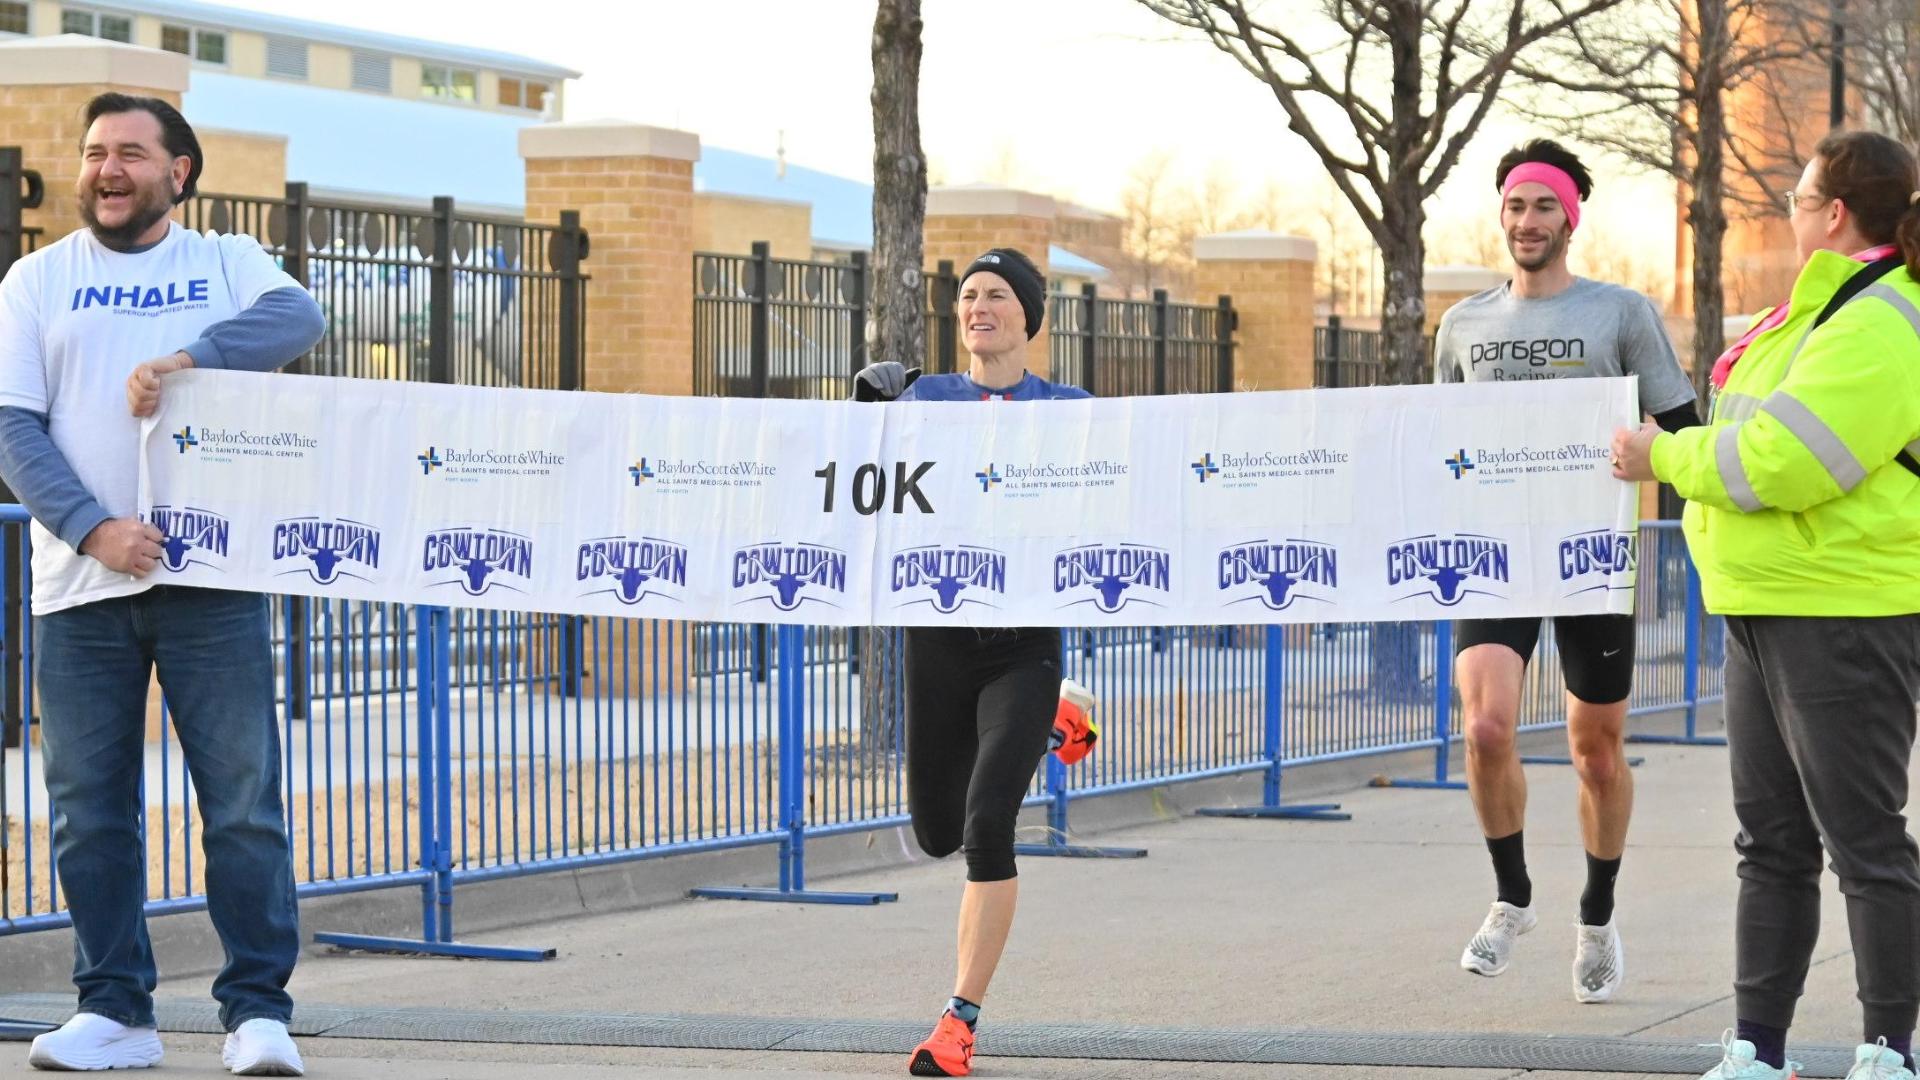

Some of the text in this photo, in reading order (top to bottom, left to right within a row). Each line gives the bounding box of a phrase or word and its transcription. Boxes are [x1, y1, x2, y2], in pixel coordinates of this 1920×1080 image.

[72, 279, 208, 311] INHALE
[1471, 338, 1585, 371] paragon
[243, 449, 273, 457] MEDICAL
[1525, 465, 1560, 473] MEDICAL
[814, 461, 937, 515] 10K
[272, 521, 380, 569] COWTOWN
[423, 532, 533, 579] COWTOWN
[576, 541, 688, 587] COWTOWN
[1218, 543, 1338, 590] COWTOWN
[1386, 538, 1509, 586] COWTOWN
[732, 546, 847, 594] COWTOWN
[890, 549, 1006, 594] COWTOWN
[1054, 548, 1170, 594] COWTOWN
